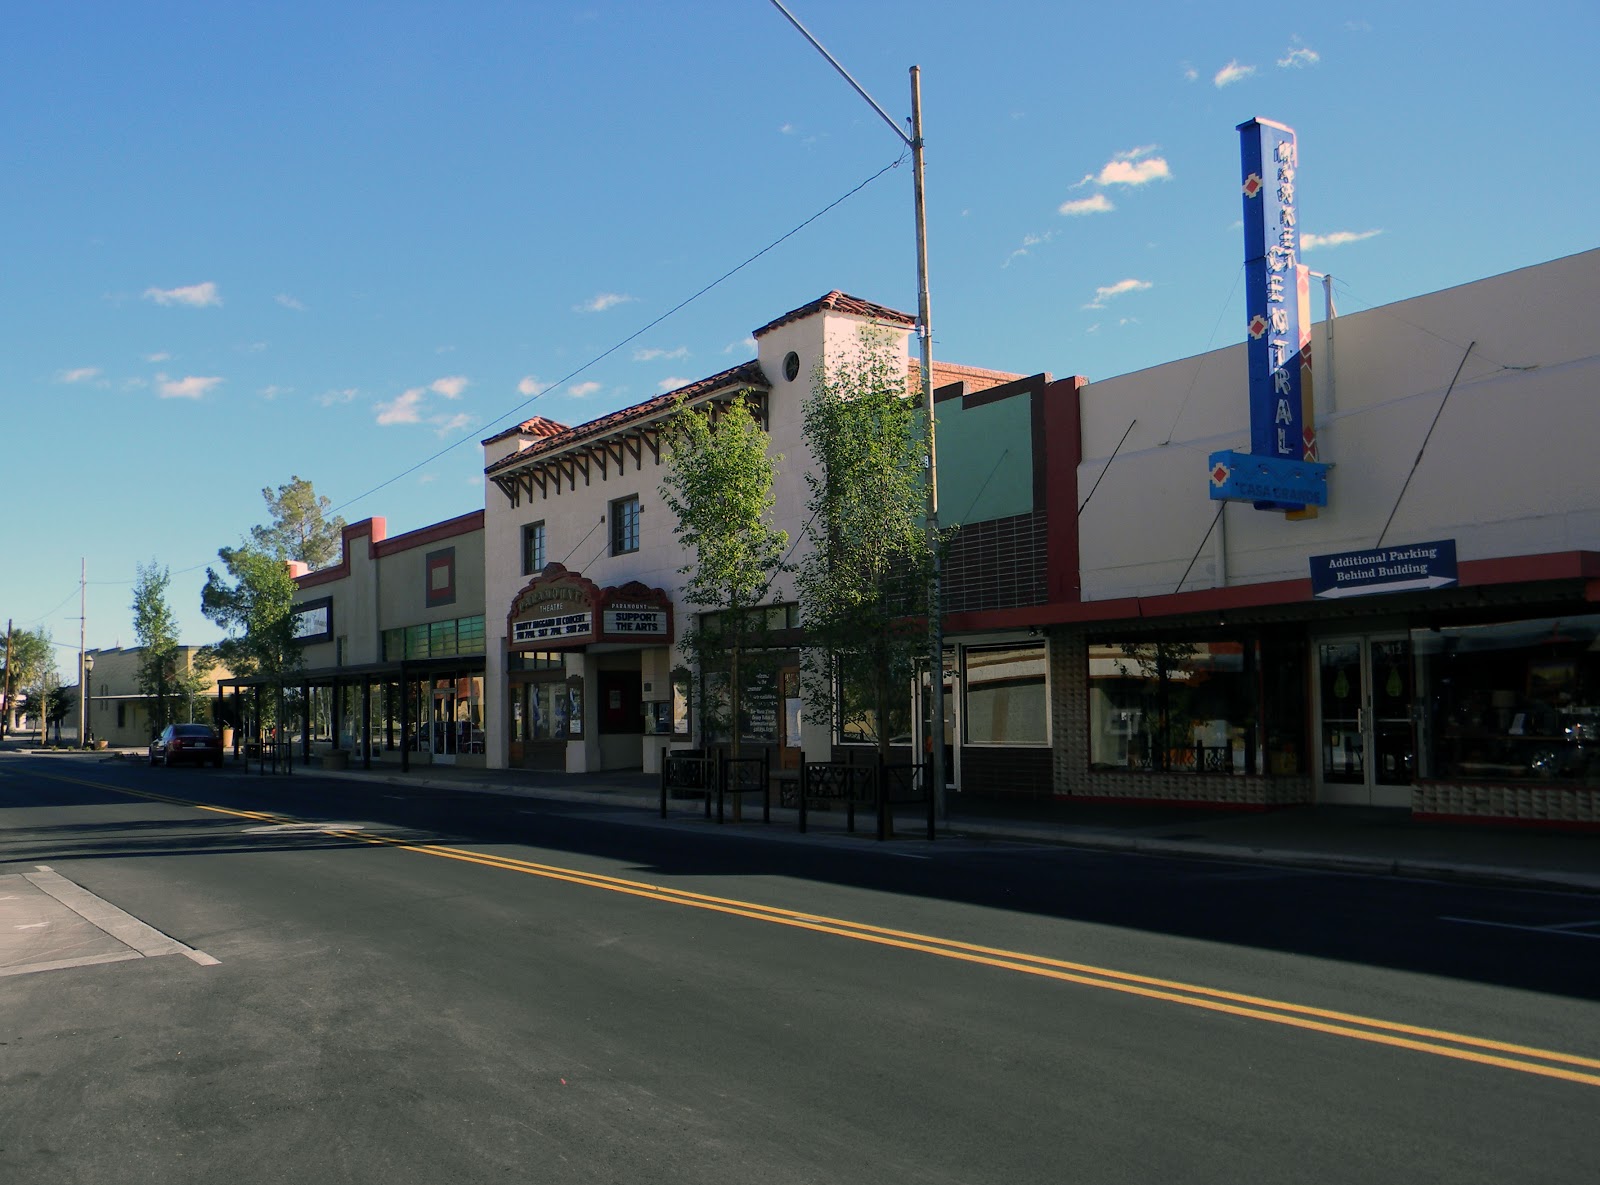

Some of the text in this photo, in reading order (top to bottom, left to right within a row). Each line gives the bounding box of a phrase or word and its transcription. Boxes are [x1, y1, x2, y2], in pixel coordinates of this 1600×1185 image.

[1266, 245, 1293, 455] CENTRAL
[1239, 483, 1271, 497] CASA
[1328, 548, 1437, 569] Additional Parking
[1336, 563, 1428, 582] Behind Building
[540, 602, 563, 613] THEATRE
[562, 614, 586, 625] CONCERT
[615, 612, 658, 622] SUPPORT
[615, 622, 658, 631] THE ARTS
